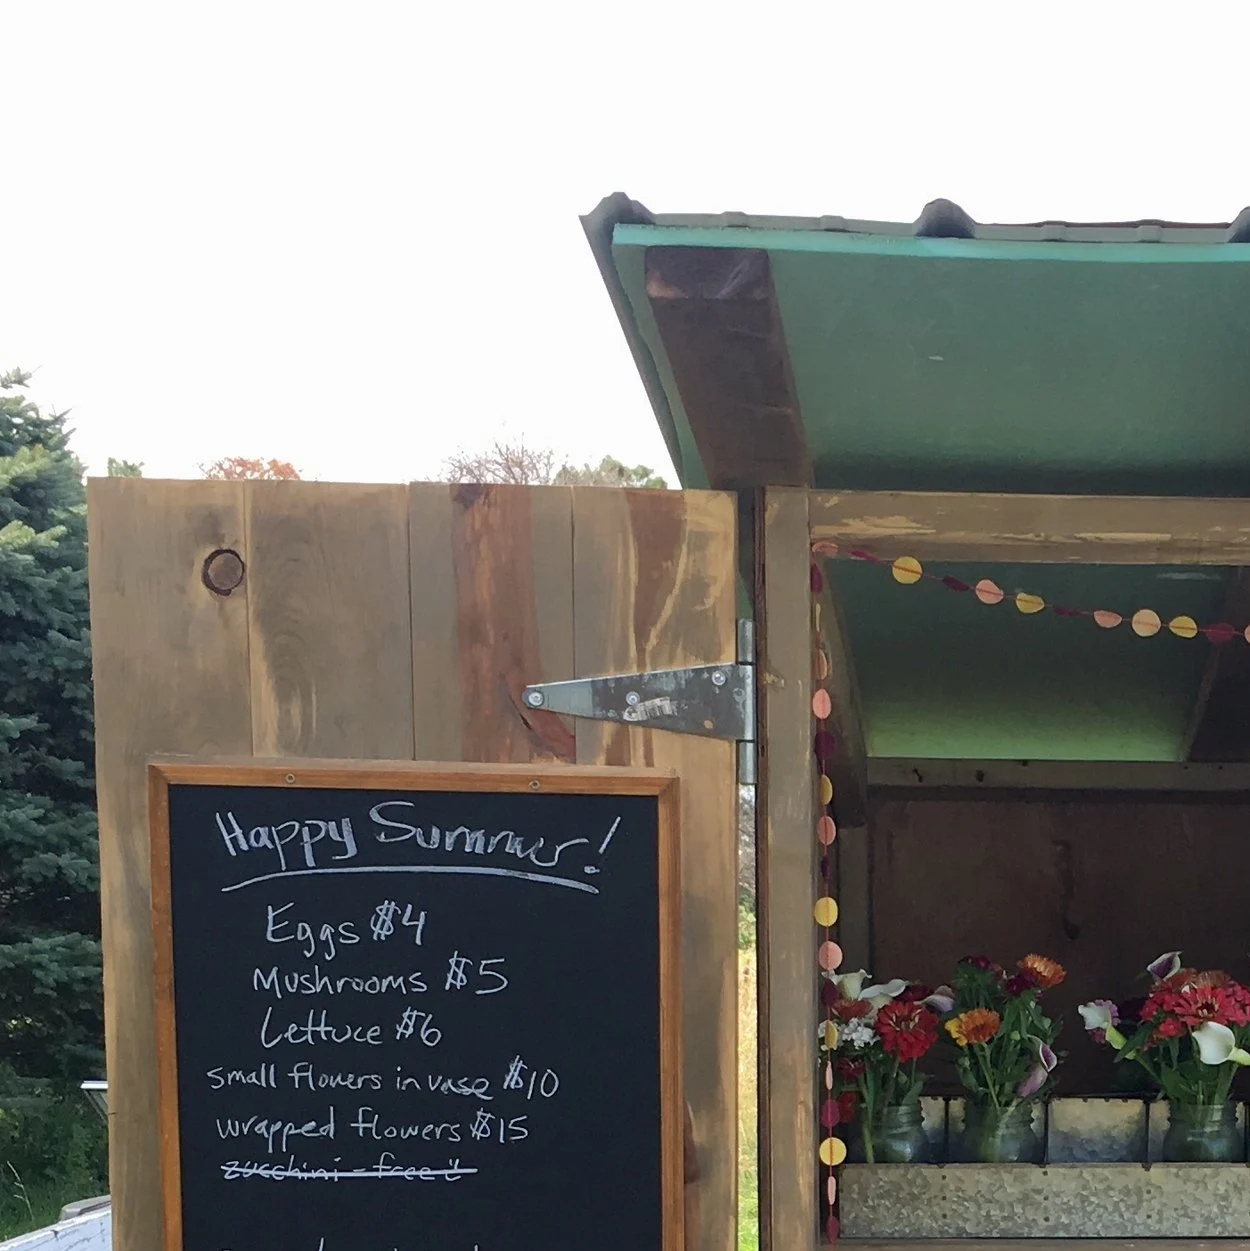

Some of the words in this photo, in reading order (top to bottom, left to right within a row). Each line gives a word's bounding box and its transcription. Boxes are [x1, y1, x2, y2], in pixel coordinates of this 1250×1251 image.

[215, 811, 358, 871] Happy
[266, 902, 361, 961] Eggs
[370, 899, 428, 946] $4
[253, 964, 428, 999] Mushrooms
[444, 950, 509, 995] $5
[260, 1006, 383, 1049] Lettuce
[395, 1006, 442, 1047] $6
[287, 1061, 382, 1091] flowers
[396, 1065, 422, 1091] in
[428, 1074, 494, 1101] vase
[502, 1054, 560, 1100] $10
[216, 1105, 335, 1154] wrapped
[349, 1106, 462, 1142] flowers
[469, 1107, 529, 1144] $15
